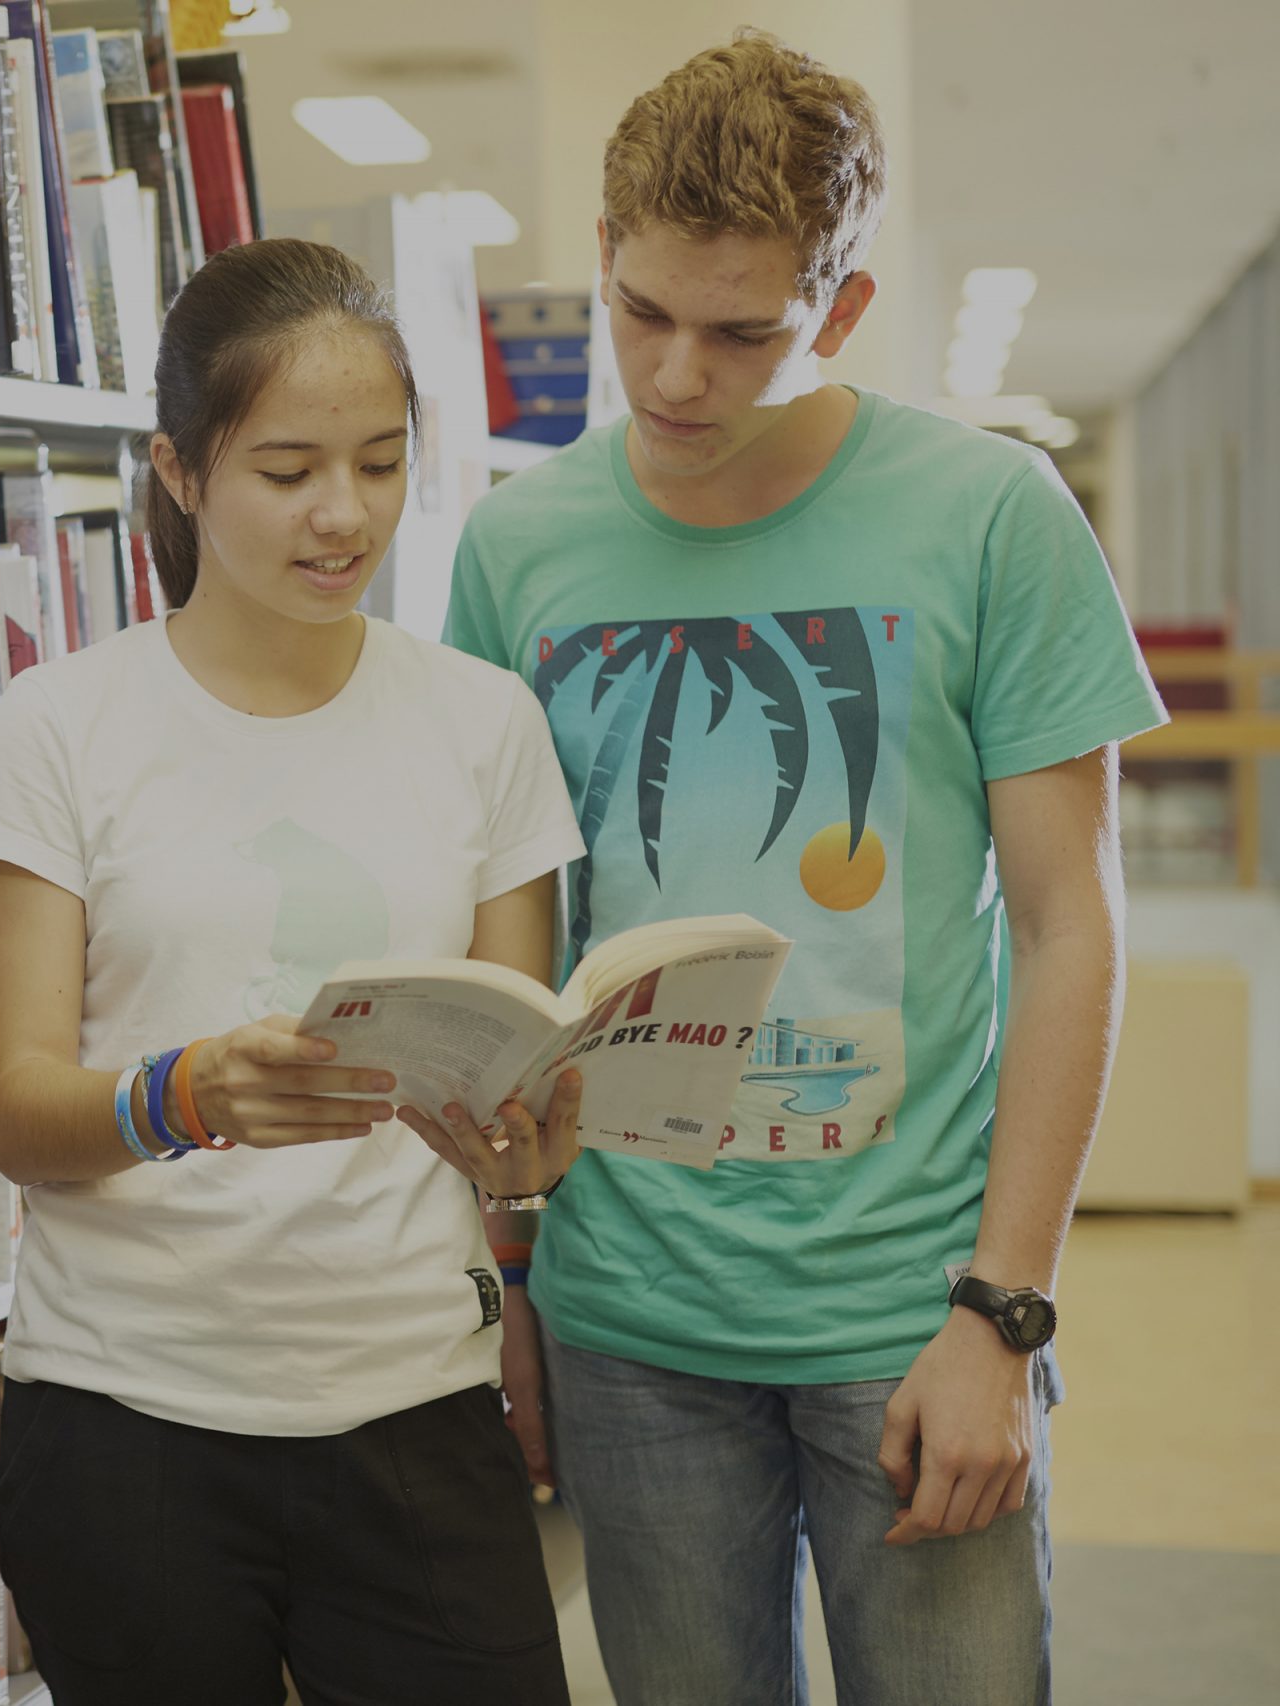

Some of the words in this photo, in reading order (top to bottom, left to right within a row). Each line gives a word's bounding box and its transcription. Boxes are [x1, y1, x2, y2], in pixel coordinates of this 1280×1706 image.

[538, 614, 900, 663] DESERT
[734, 950, 774, 962] Bobin
[608, 1024, 662, 1046] BYE
[666, 1022, 728, 1046] MAO
[734, 1026, 755, 1050] ?
